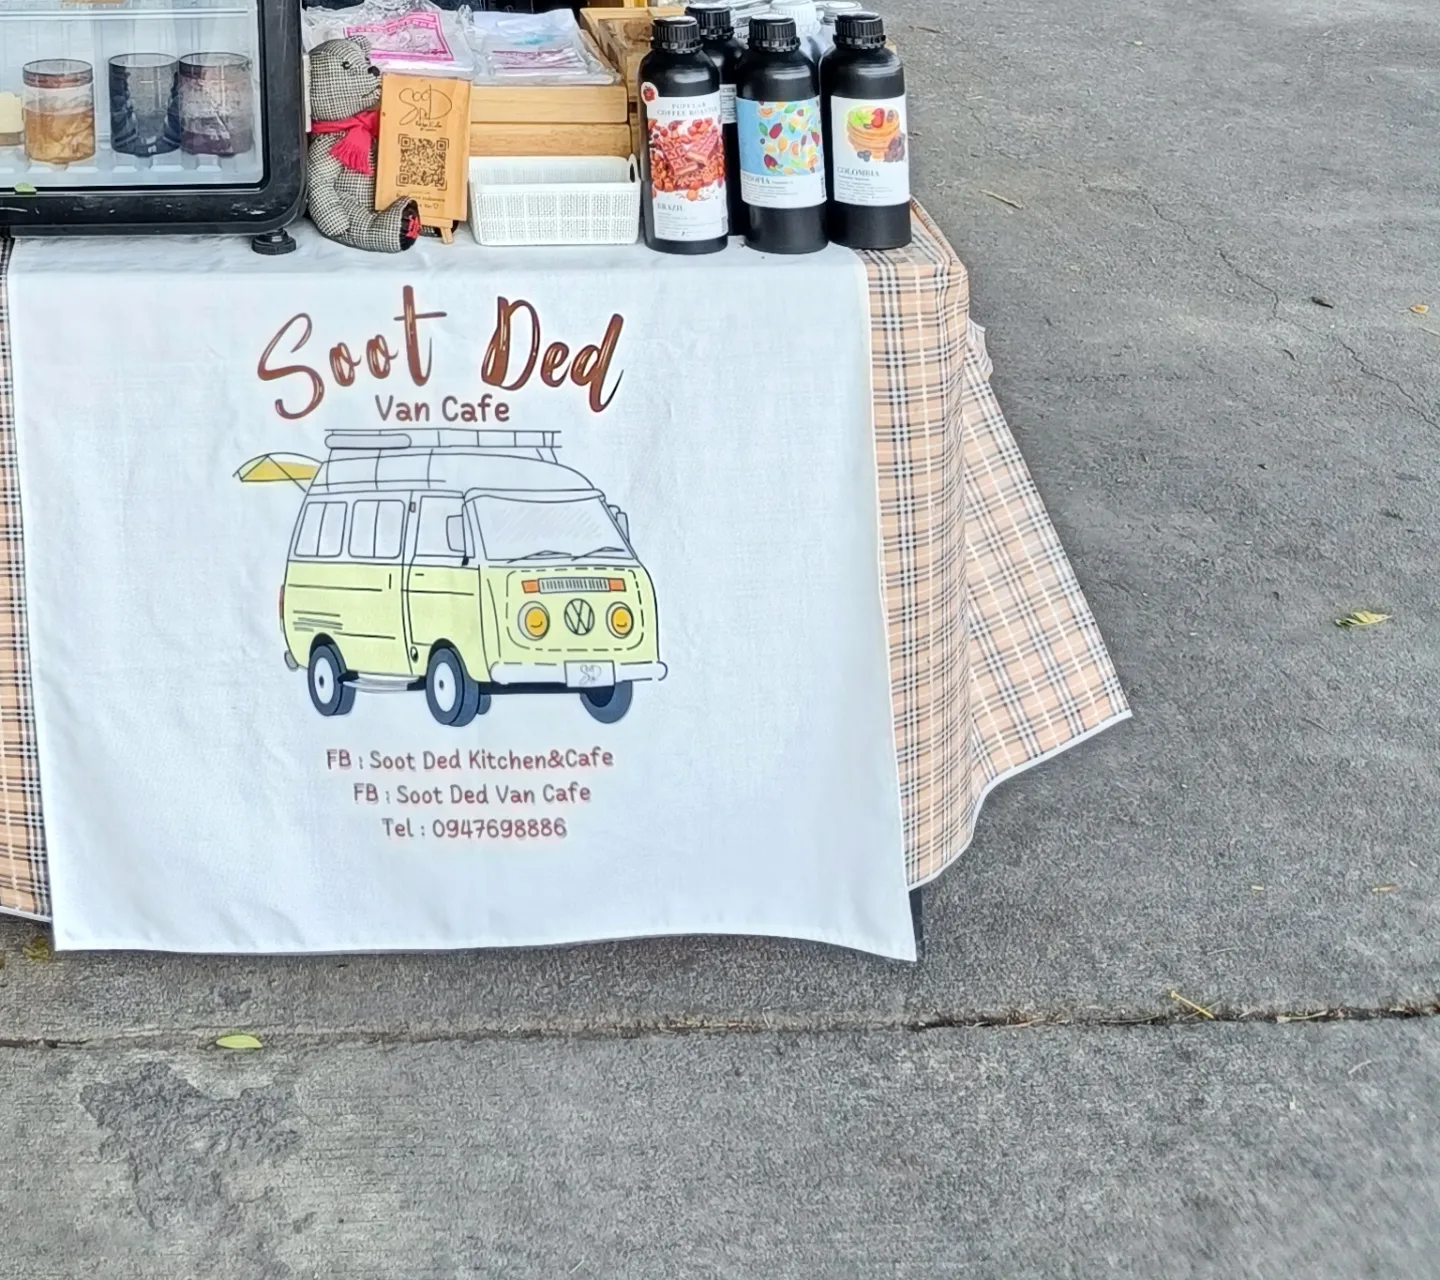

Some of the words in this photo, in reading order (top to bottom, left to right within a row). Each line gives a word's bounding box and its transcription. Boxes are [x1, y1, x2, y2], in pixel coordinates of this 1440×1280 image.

[257, 285, 451, 421] Soot
[478, 296, 623, 416] Ded
[375, 395, 429, 421] Van
[442, 394, 509, 422] Cafe
[327, 750, 351, 769] FB
[370, 750, 415, 770] Soot
[423, 749, 461, 769] Ded
[469, 746, 613, 769] Kitchen&Cafe
[354, 783, 378, 801] FB
[397, 785, 443, 804] Soot
[450, 784, 489, 804] Ded
[496, 785, 534, 803] Van
[543, 782, 590, 802] Cafe
[382, 818, 414, 837] Tel
[433, 818, 566, 838] 0947698886
